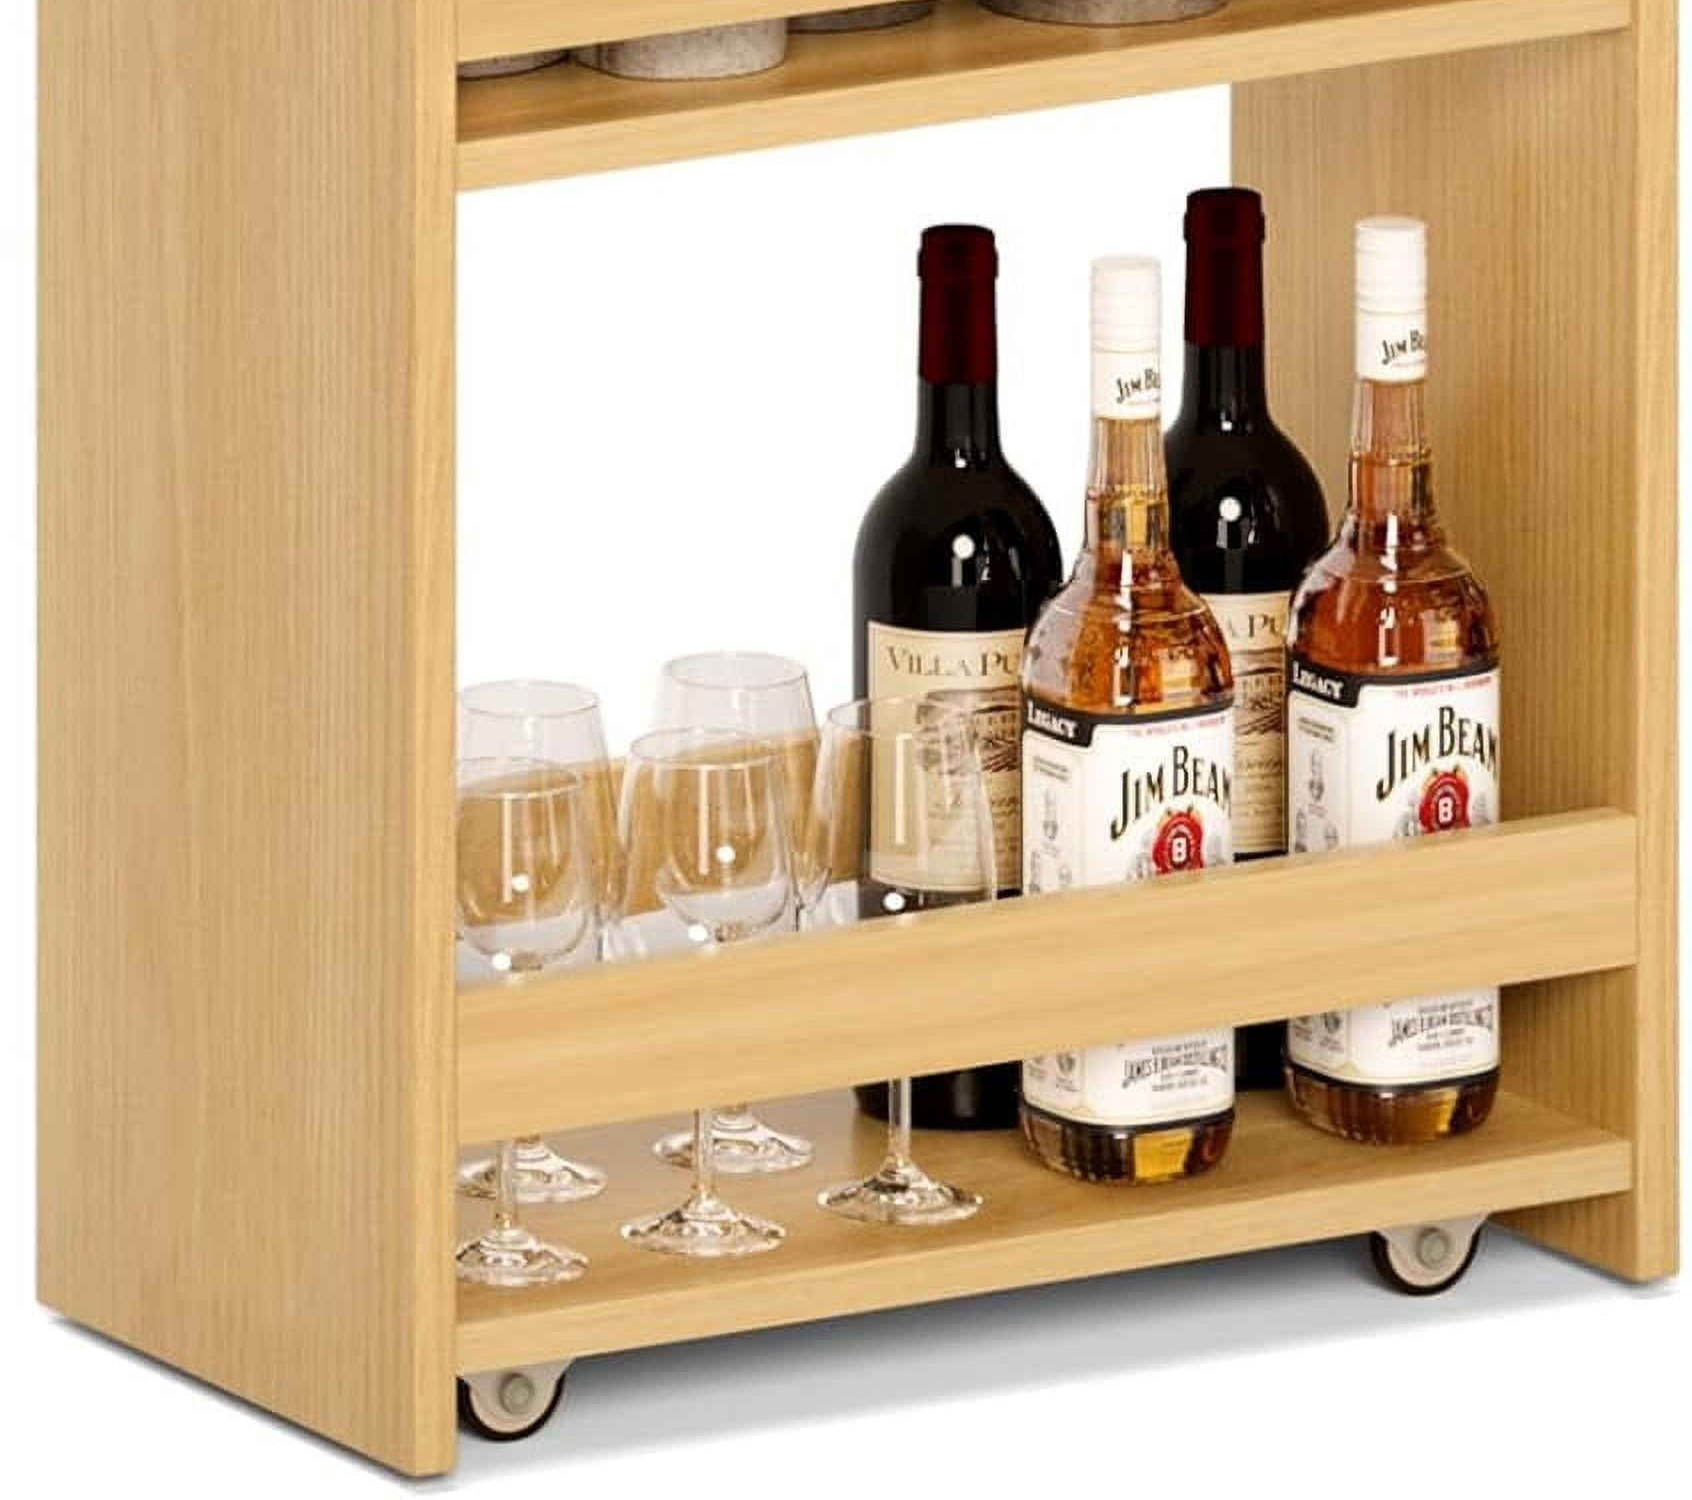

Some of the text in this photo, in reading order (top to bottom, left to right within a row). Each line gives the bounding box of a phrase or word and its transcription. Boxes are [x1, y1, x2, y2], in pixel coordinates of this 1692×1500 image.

[887, 645, 972, 677] VILLA
[1292, 660, 1345, 699] LEGACY
[1027, 698, 1078, 739] LEGACY
[1376, 723, 1431, 802] JIM
[1111, 764, 1165, 841] JIM
